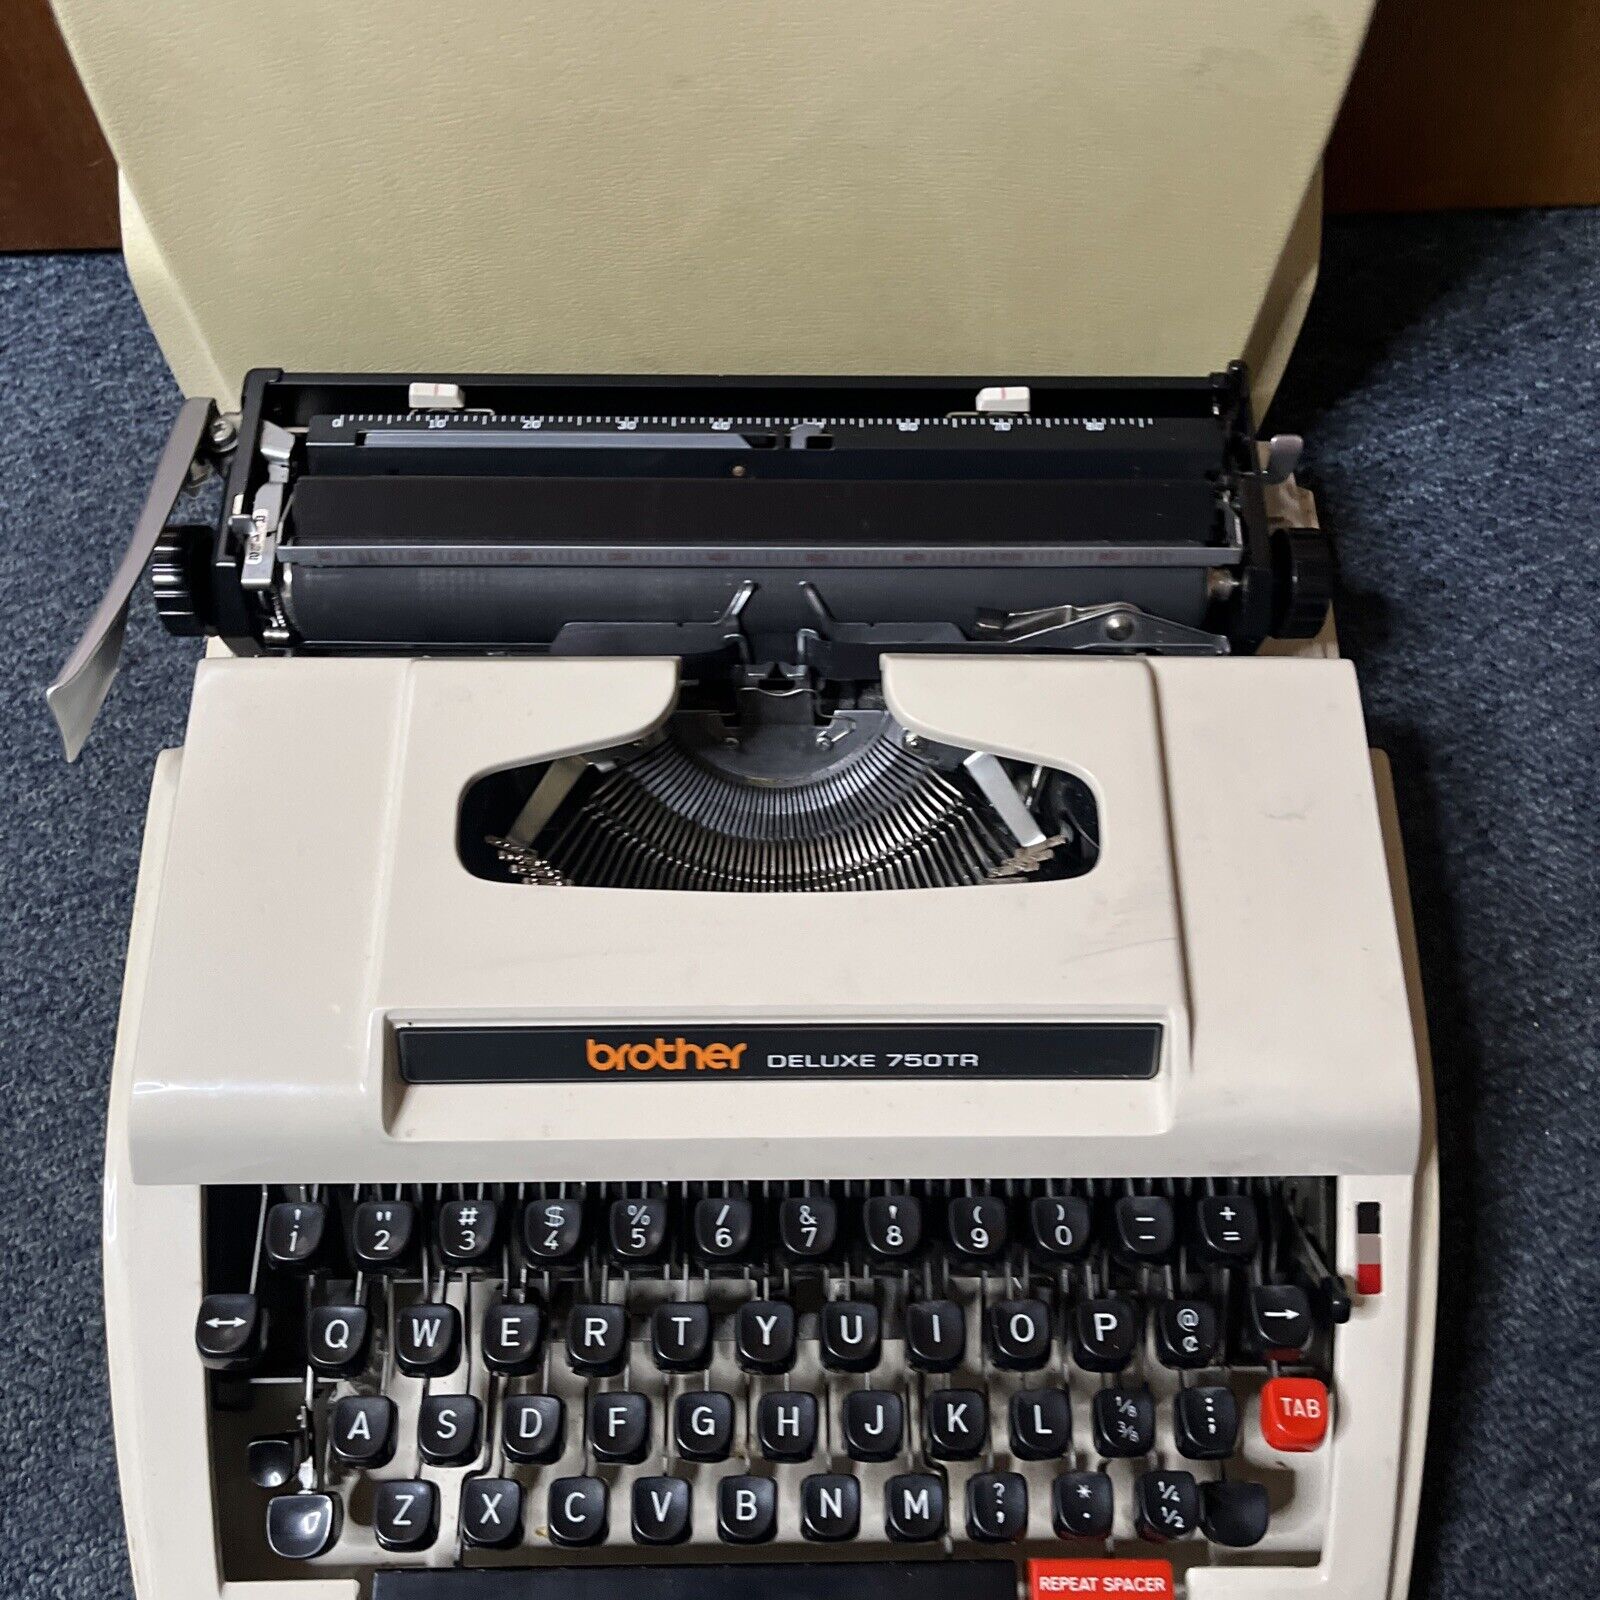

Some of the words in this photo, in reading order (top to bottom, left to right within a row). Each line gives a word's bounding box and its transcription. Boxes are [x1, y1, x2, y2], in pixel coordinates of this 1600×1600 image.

[428, 419, 447, 430] 10
[521, 419, 541, 430] 20
[617, 420, 637, 431] 30
[586, 1038, 747, 1071] brother
[767, 1053, 876, 1068] DELUXE
[886, 1053, 979, 1068] 750TR
[458, 1207, 479, 1226] #
[545, 1206, 565, 1227] $
[627, 1205, 651, 1226] %
[715, 1204, 730, 1226] /
[799, 1205, 818, 1224] &
[973, 1204, 983, 1224] (
[1056, 1204, 1065, 1221] )
[1219, 1206, 1236, 1221] +
[373, 1230, 390, 1251] 2
[459, 1230, 476, 1250] 3
[543, 1230, 560, 1250] 4
[631, 1228, 646, 1249] 5
[715, 1228, 734, 1248] 6
[801, 1227, 818, 1247] 7
[885, 1225, 904, 1246] 8
[970, 1227, 989, 1248] 9
[1055, 1225, 1073, 1246] 0
[1223, 1231, 1242, 1241] =
[324, 1319, 350, 1349] Q
[412, 1318, 441, 1348] W
[501, 1317, 521, 1347] E
[584, 1317, 609, 1347] R
[671, 1316, 692, 1346] T
[756, 1315, 778, 1345] Y
[840, 1315, 863, 1344] U
[932, 1314, 941, 1343] I
[1009, 1313, 1035, 1343] O
[1093, 1313, 1117, 1342] P
[1176, 1308, 1199, 1332] @
[691, 1406, 715, 1437] G
[777, 1406, 799, 1437] H
[864, 1405, 885, 1435] J
[947, 1403, 969, 1434] K
[1033, 1403, 1053, 1435] L
[1280, 1396, 1321, 1419] TAB
[347, 1410, 371, 1440] A
[437, 1408, 457, 1439] S
[519, 1407, 543, 1439] D
[608, 1407, 628, 1438] F
[564, 1491, 587, 1523] C
[650, 1490, 673, 1523] V
[735, 1489, 758, 1521] B
[820, 1487, 842, 1519] N
[903, 1488, 930, 1520] M
[992, 1481, 1006, 1504] ?
[393, 1494, 415, 1527] Z
[480, 1493, 503, 1525] X
[1038, 1576, 1099, 1593] REPEAT
[1103, 1576, 1167, 1593] SPACER
